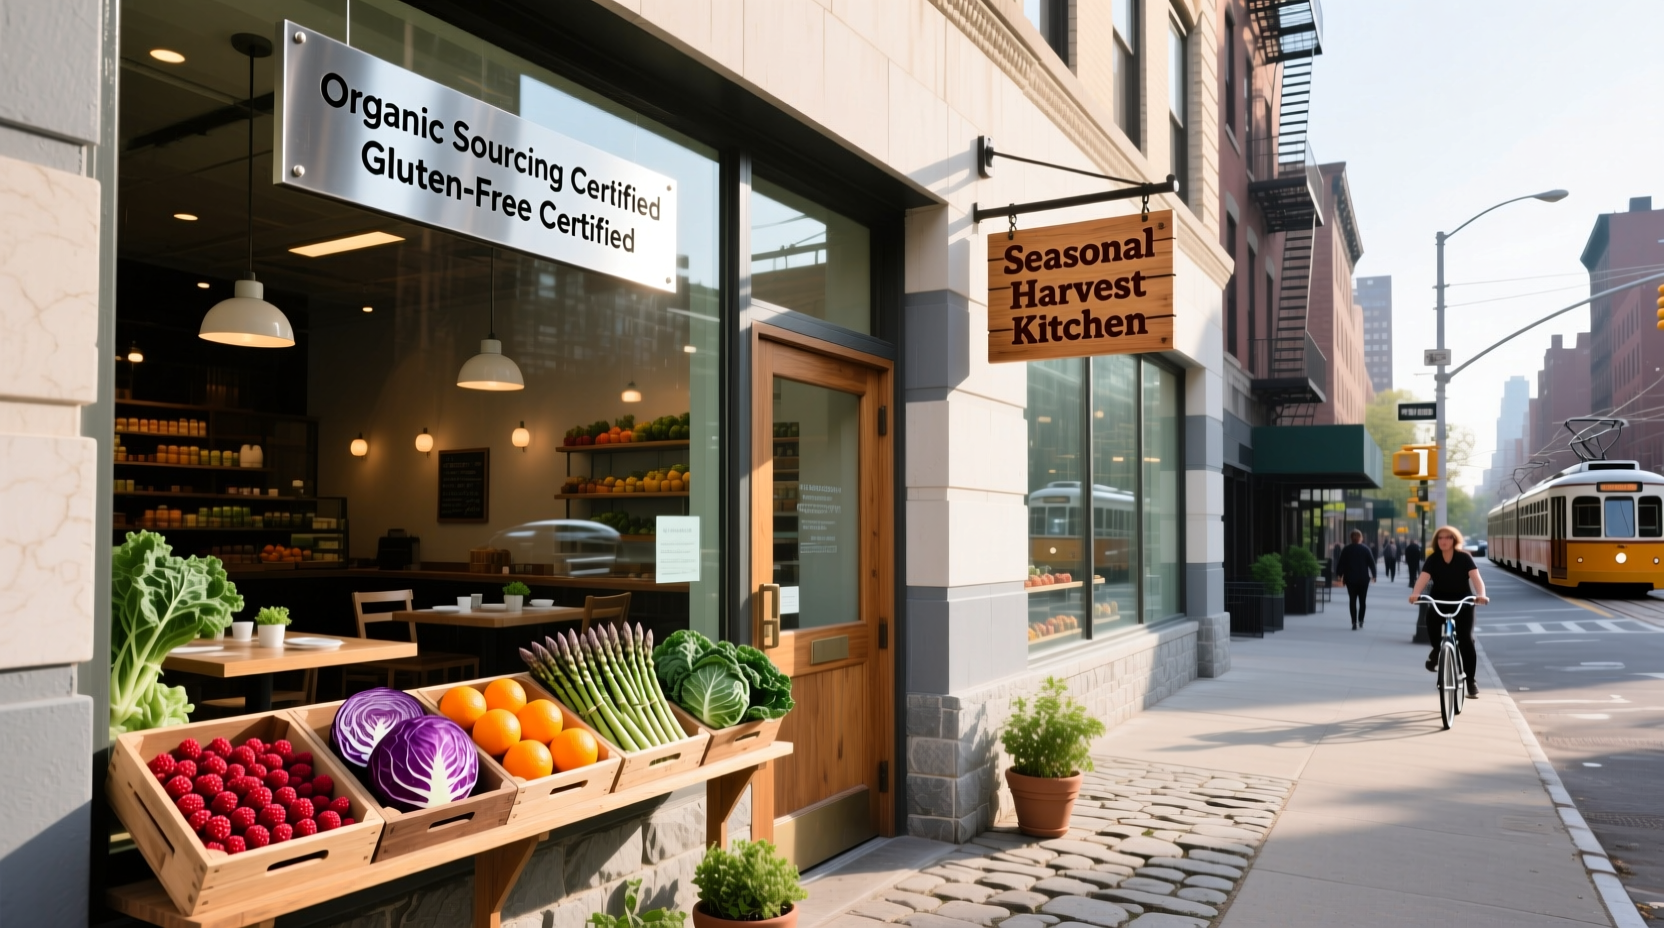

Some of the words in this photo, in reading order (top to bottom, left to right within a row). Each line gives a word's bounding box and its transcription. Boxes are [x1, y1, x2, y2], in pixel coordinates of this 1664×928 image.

[320, 72, 444, 144] Organic
[453, 120, 563, 192] Sourcing
[571, 167, 661, 221] Certified
[361, 140, 532, 221] Gluten-Free
[539, 200, 635, 253] Certified
[1003, 226, 1155, 275] Seasonal
[1009, 270, 1147, 310] Harvest
[1011, 308, 1149, 345] Kitchen
